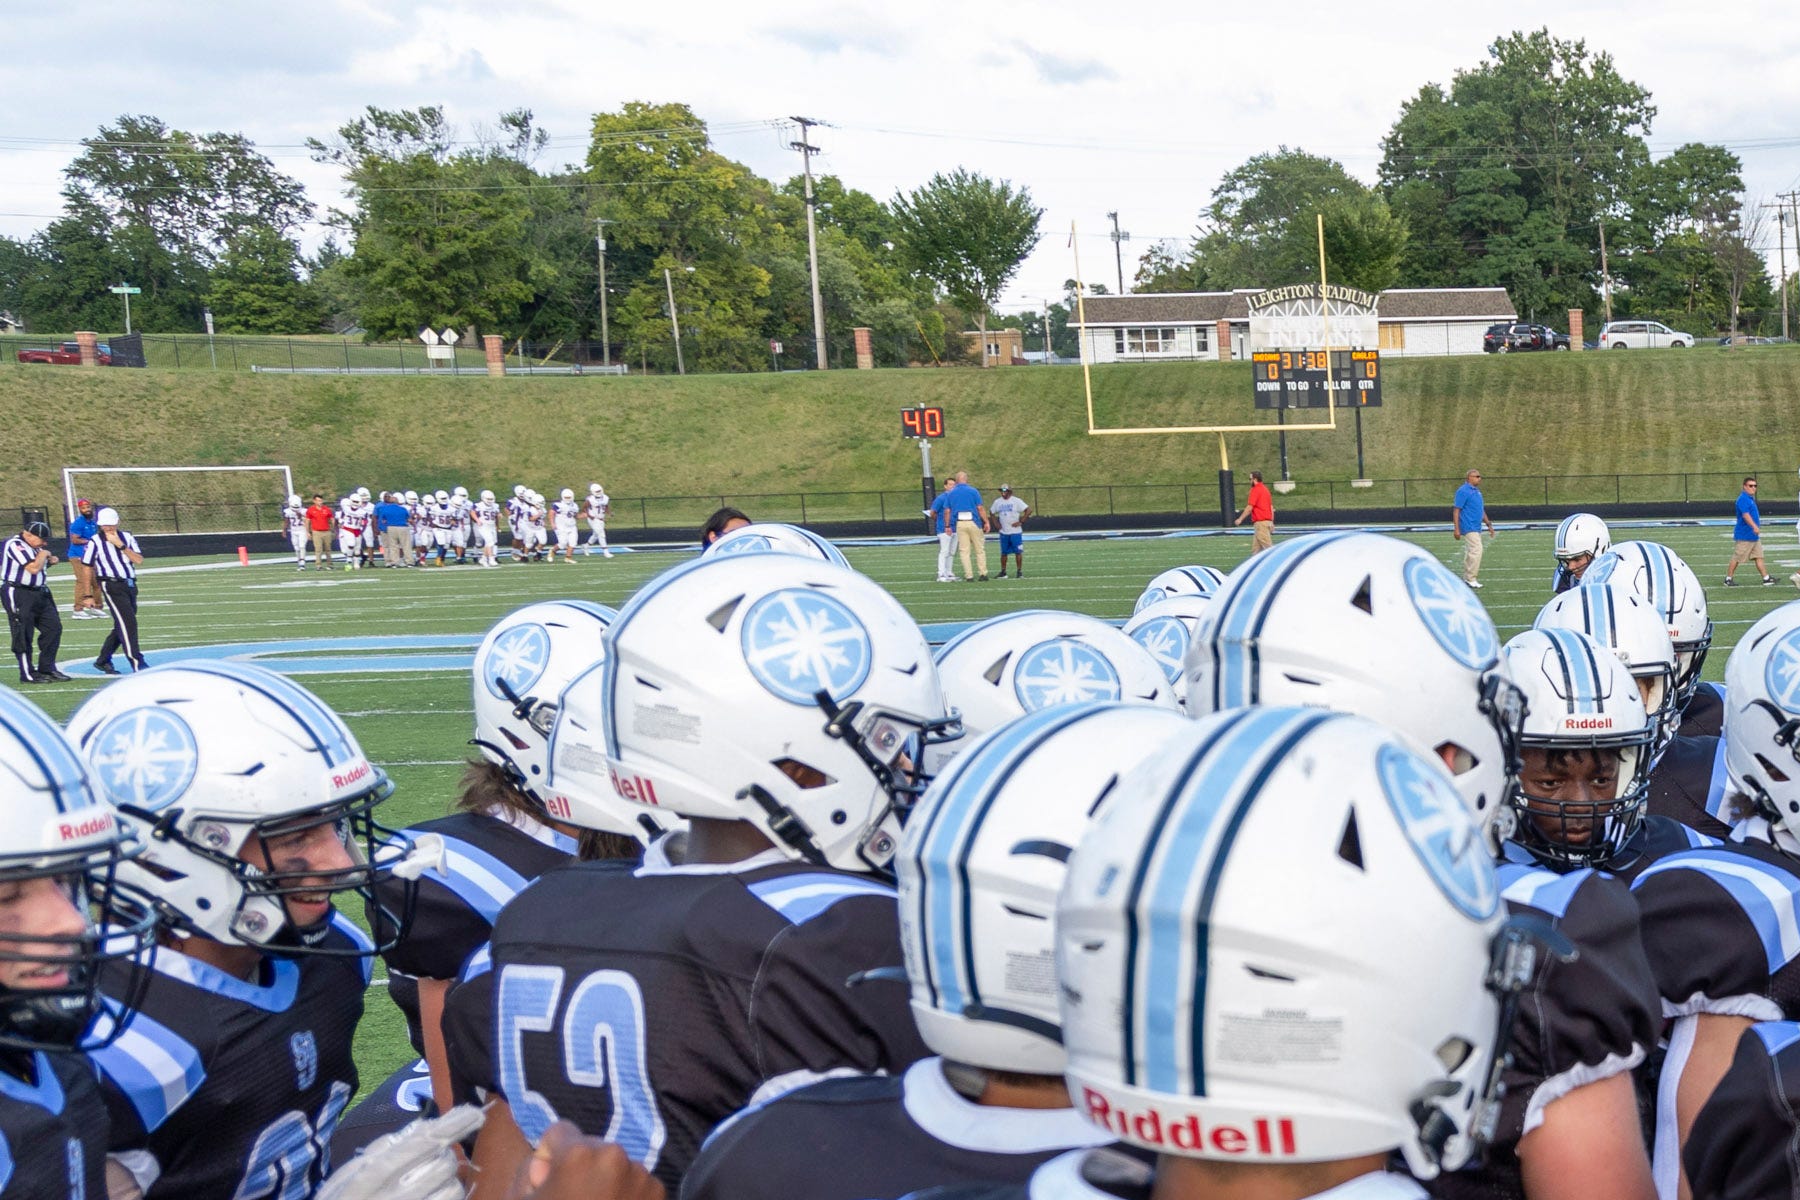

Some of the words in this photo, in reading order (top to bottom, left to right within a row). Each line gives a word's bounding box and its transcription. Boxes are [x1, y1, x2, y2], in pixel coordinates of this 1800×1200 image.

[1252, 284, 1314, 309] LEIGHTON
[1317, 284, 1374, 308] STADIUM
[1268, 328, 1363, 348] INDIANS
[1281, 352, 1327, 370] 31:38
[1366, 361, 1377, 379] 0
[1267, 363, 1279, 380] 0
[1256, 382, 1281, 392] DOWN
[1286, 381, 1297, 391] TO
[1298, 381, 1309, 391] GO
[1323, 380, 1341, 390] BLL
[1358, 379, 1375, 390] QTR
[1361, 390, 1367, 405] 1
[903, 408, 943, 437] 40
[1565, 717, 1613, 730] Riddell
[332, 762, 371, 790] Riddell
[58, 812, 114, 842] Riddell
[1082, 1085, 1298, 1156] Riddell
